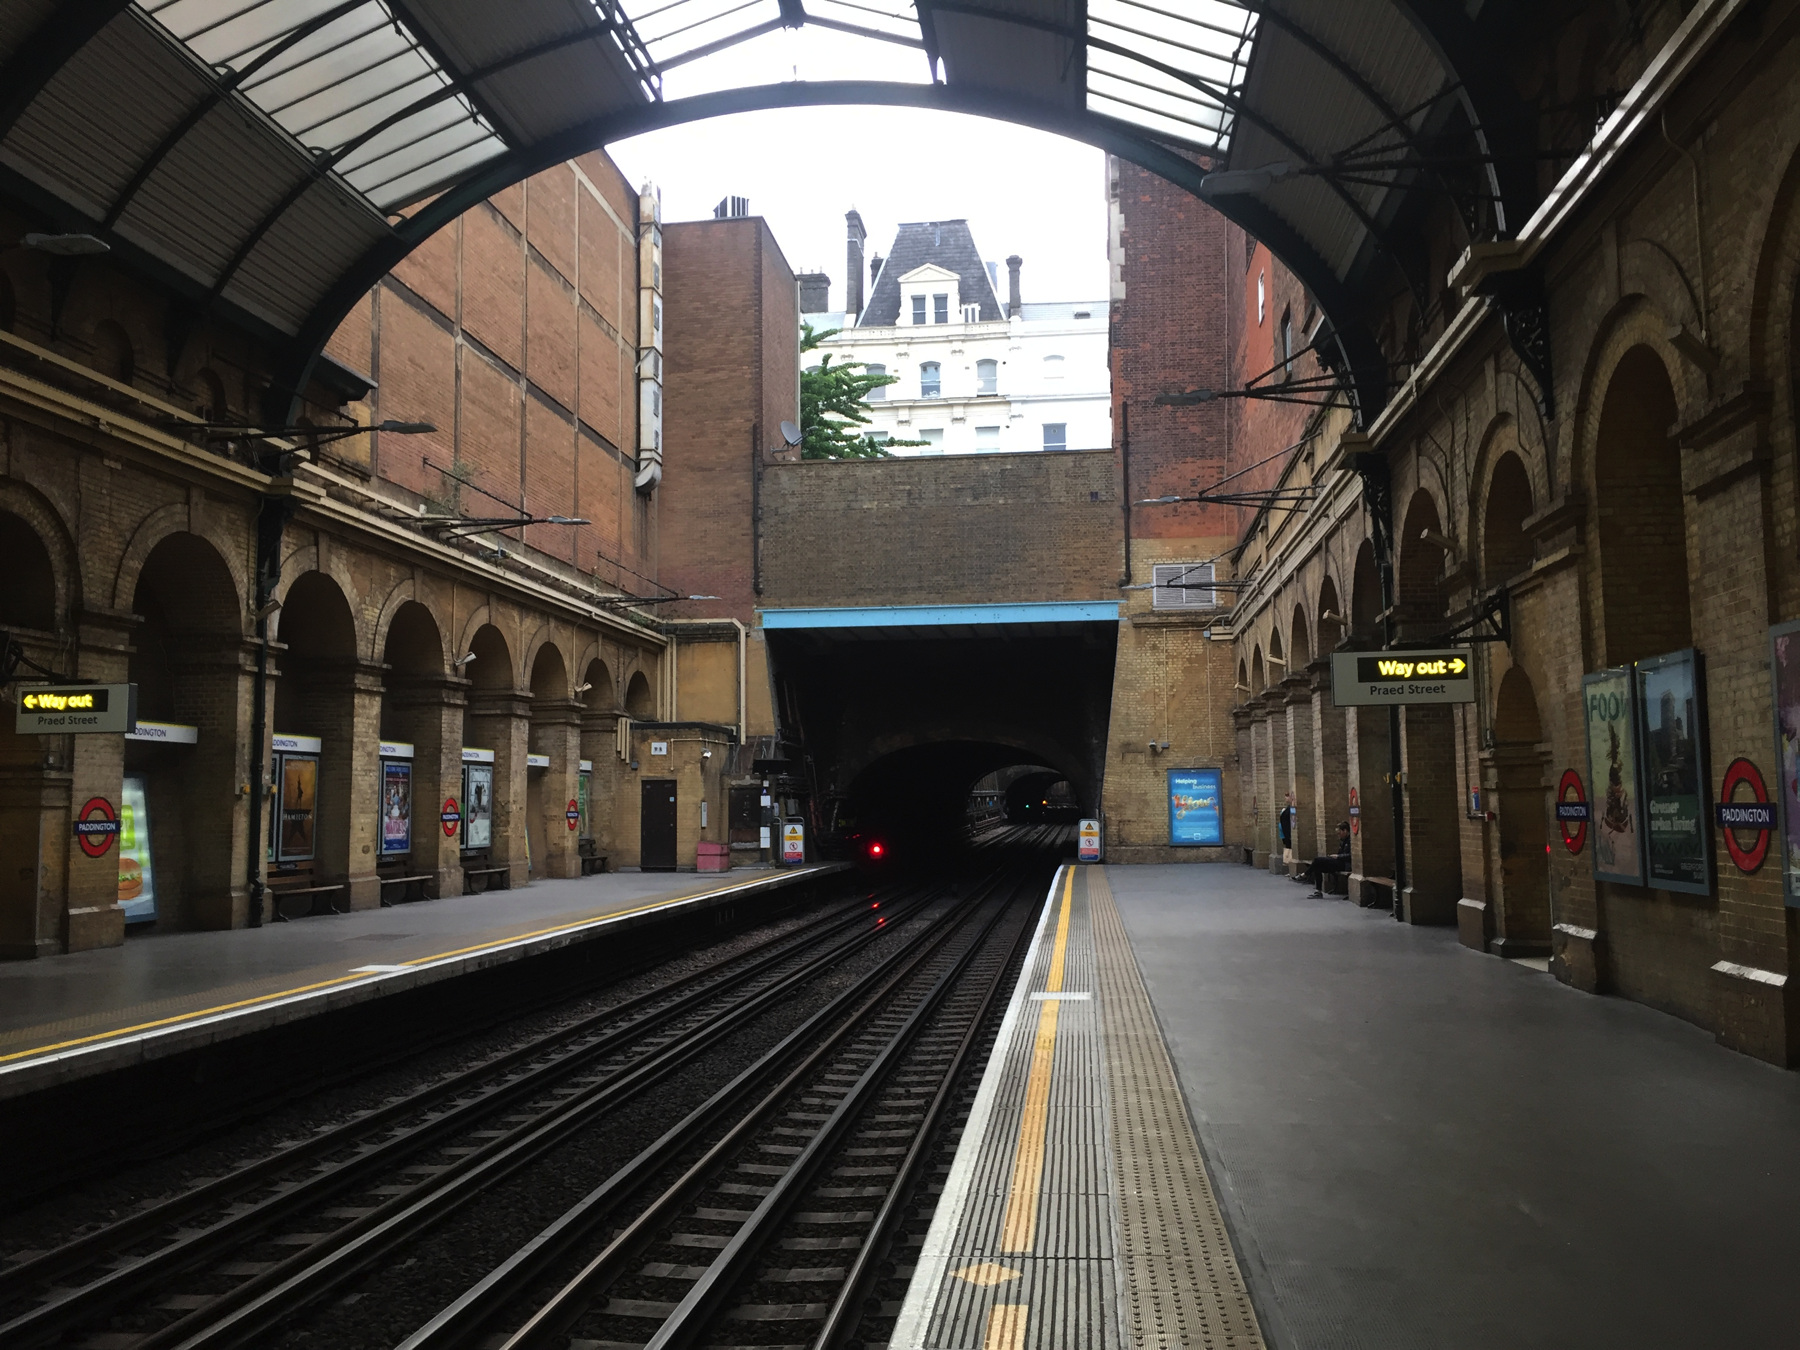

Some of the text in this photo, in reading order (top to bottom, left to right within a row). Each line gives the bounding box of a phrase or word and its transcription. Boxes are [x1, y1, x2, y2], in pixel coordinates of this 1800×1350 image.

[1378, 659, 1447, 679] Way out
[1370, 683, 1446, 696] Praed Street
[38, 693, 93, 710] Way out
[38, 716, 98, 726] Praed Street
[128, 727, 167, 738] DDINGTON
[1559, 805, 1588, 817] PADDINGTON
[1650, 799, 1680, 814] Greener
[1721, 808, 1770, 823] PADDINGTON
[78, 822, 116, 832] PADDINGTON
[1672, 815, 1698, 835] living
